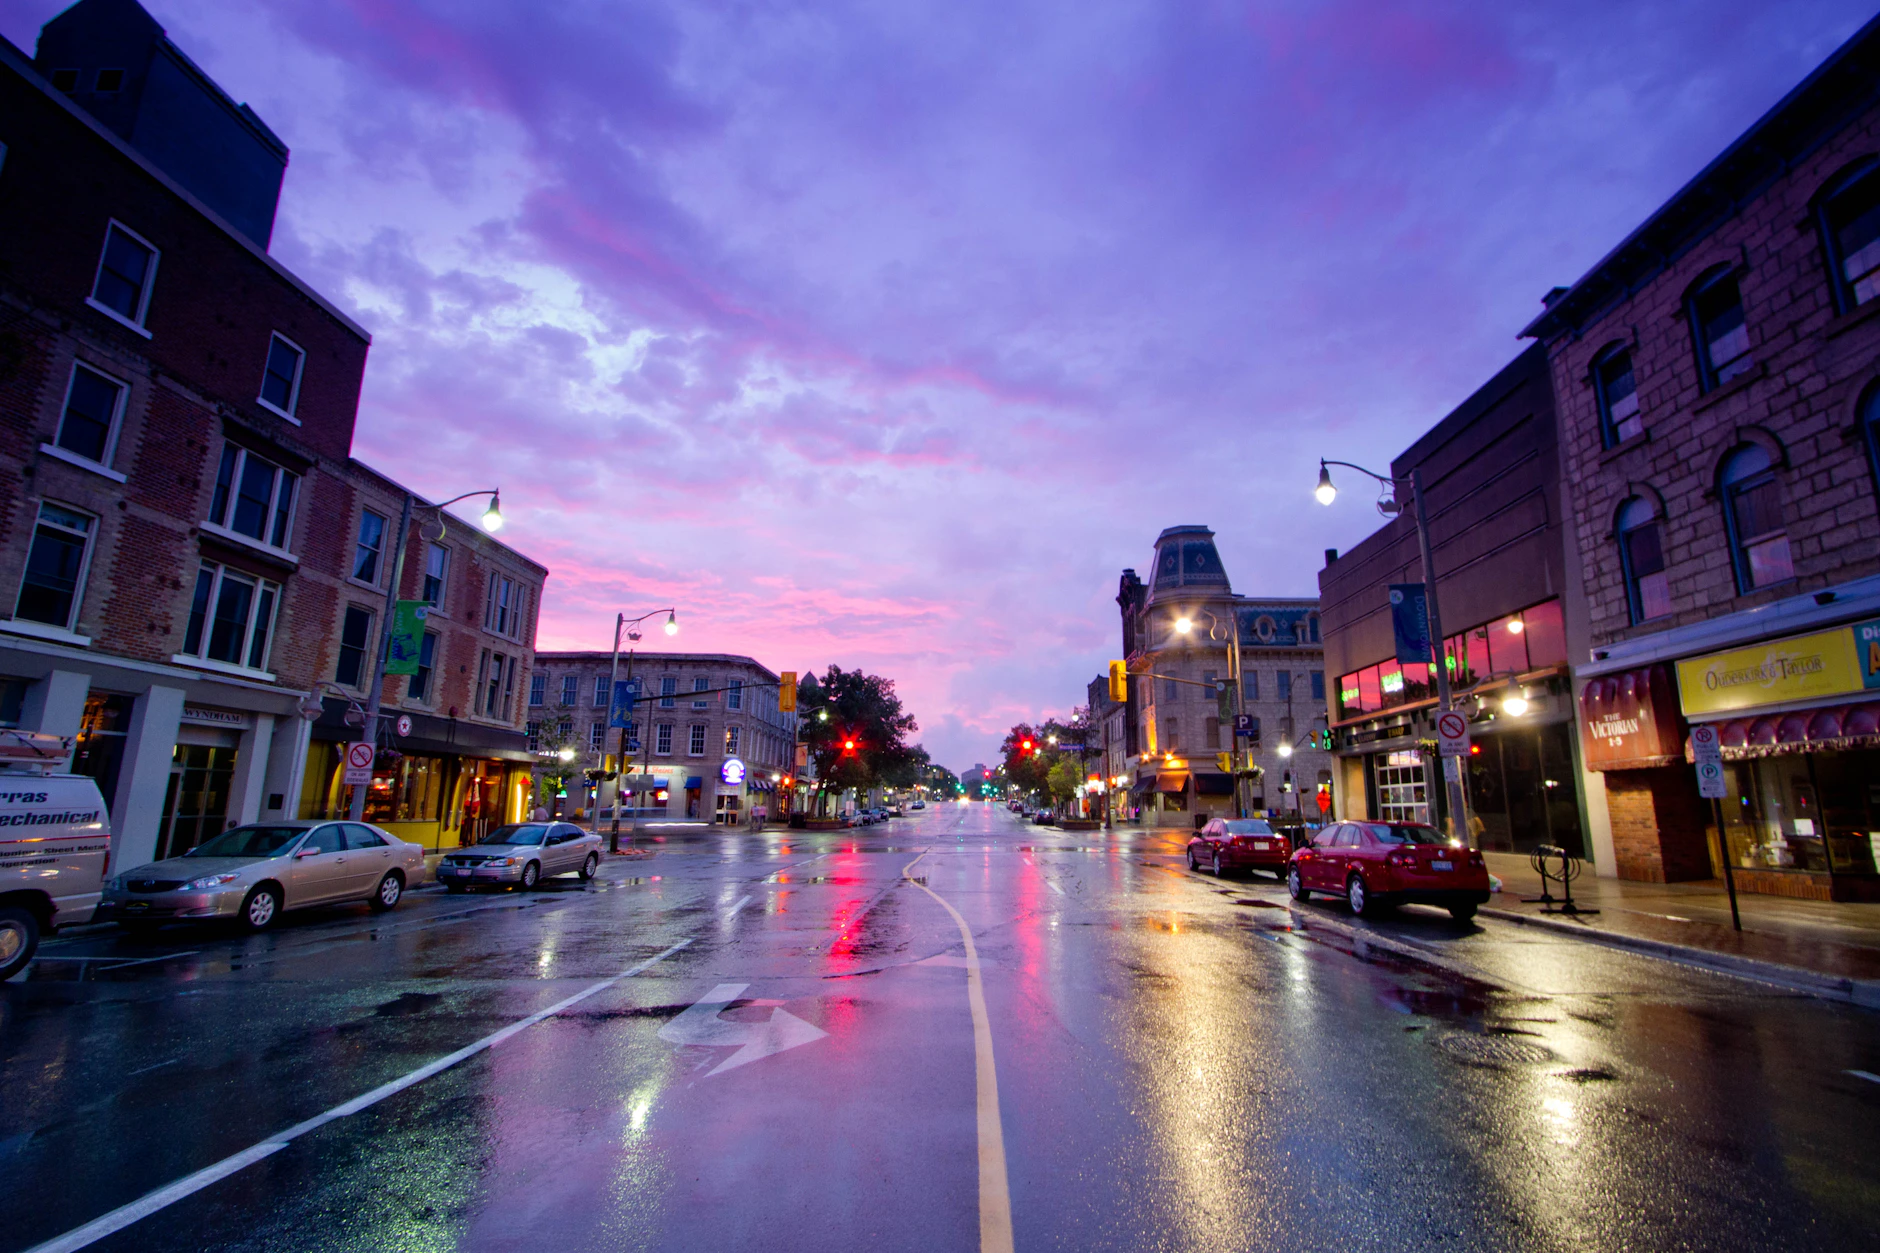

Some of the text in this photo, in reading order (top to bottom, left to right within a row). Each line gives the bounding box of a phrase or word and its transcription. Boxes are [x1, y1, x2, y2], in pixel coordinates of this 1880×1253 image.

[1414, 595, 1431, 660] DOWNTOWN
[185, 708, 240, 722] WYNDHAM
[1603, 713, 1621, 722] THE
[1239, 716, 1249, 729] P
[1588, 718, 1639, 740] VICTORIAN
[44, 847, 74, 855] Sheet
